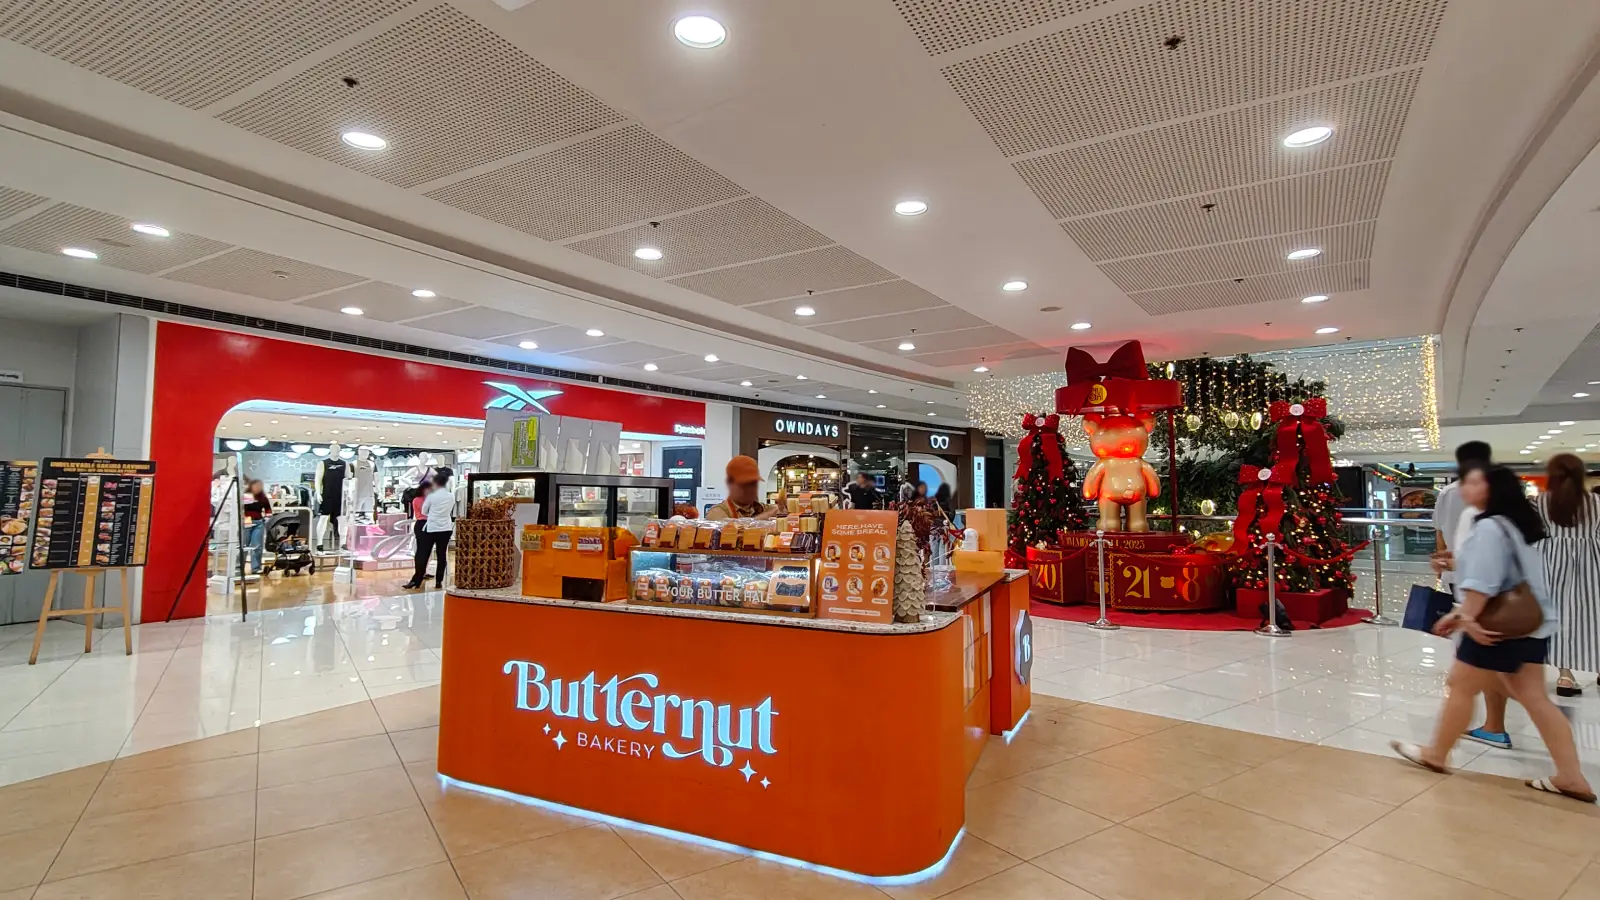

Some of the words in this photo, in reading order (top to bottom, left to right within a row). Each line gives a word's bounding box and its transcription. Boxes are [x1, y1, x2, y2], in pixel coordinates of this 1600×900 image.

[776, 419, 839, 438] OWNDAYS
[1123, 539, 1145, 550] 2025
[664, 586, 694, 599] YOUR
[697, 588, 741, 601] BUTTER
[744, 591, 773, 604] HALF
[1123, 565, 1151, 599] 21
[1022, 633, 1031, 663] B
[503, 660, 780, 767] Butternut
[577, 732, 655, 759] BAKERY
